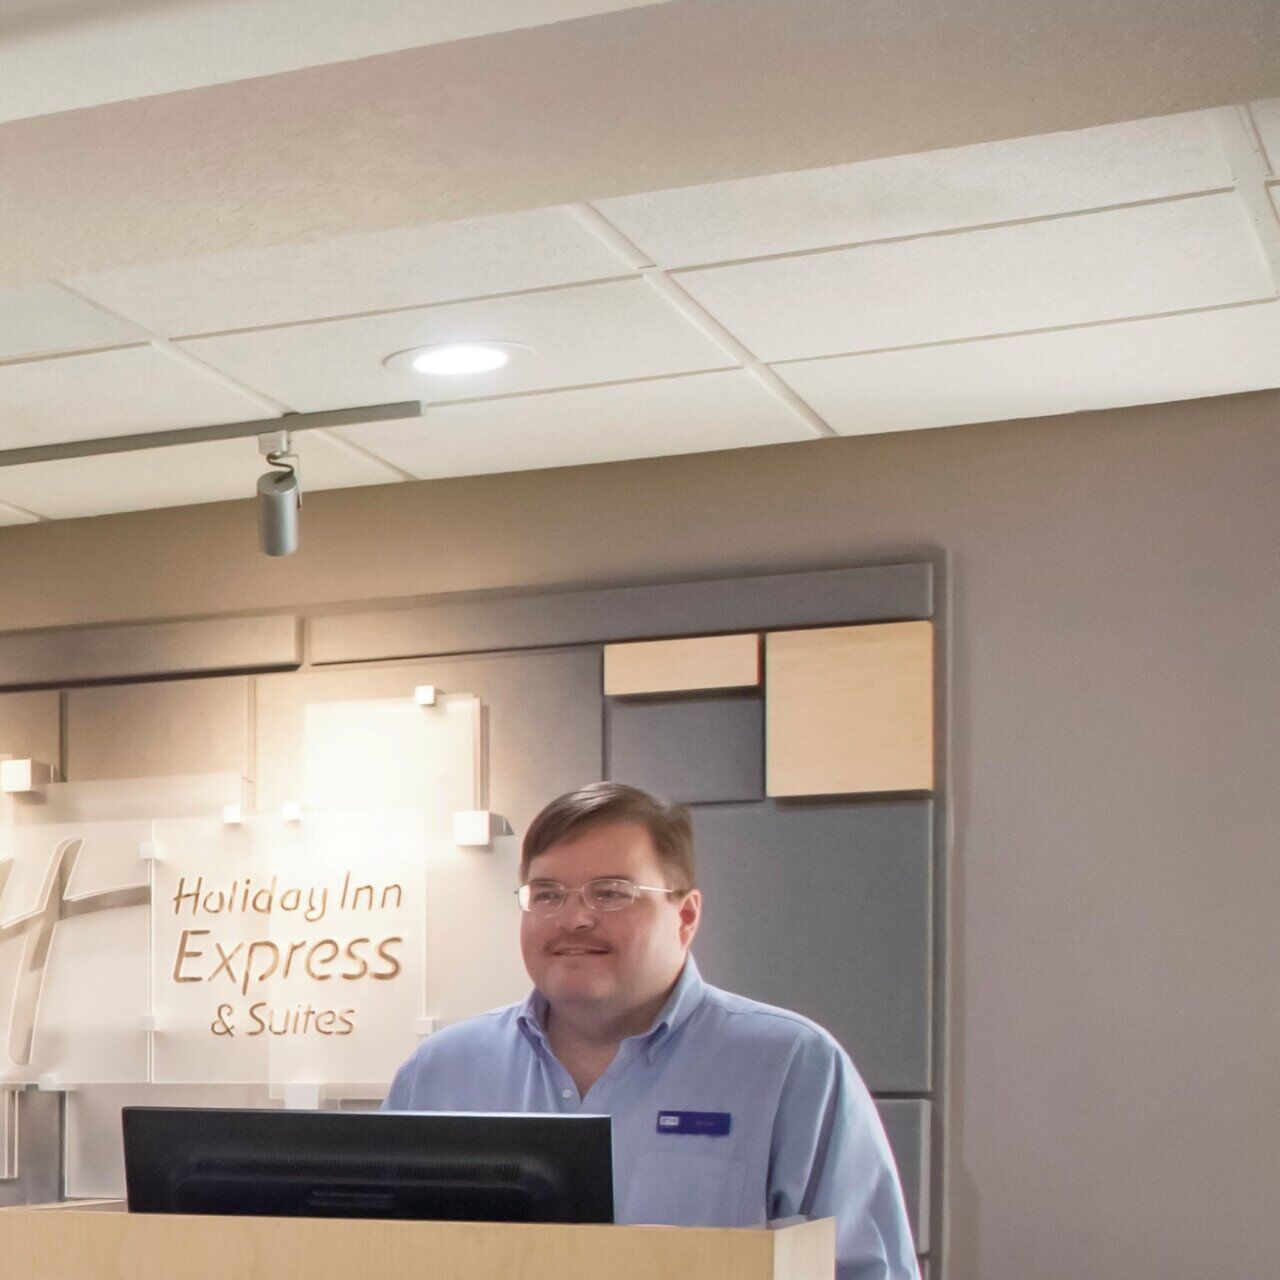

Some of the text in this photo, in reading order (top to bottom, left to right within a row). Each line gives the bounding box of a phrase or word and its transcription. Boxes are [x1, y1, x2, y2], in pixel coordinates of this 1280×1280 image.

[172, 871, 402, 922] Holiday Inn
[172, 929, 403, 996] Express
[210, 1002, 355, 1037] & Suites
